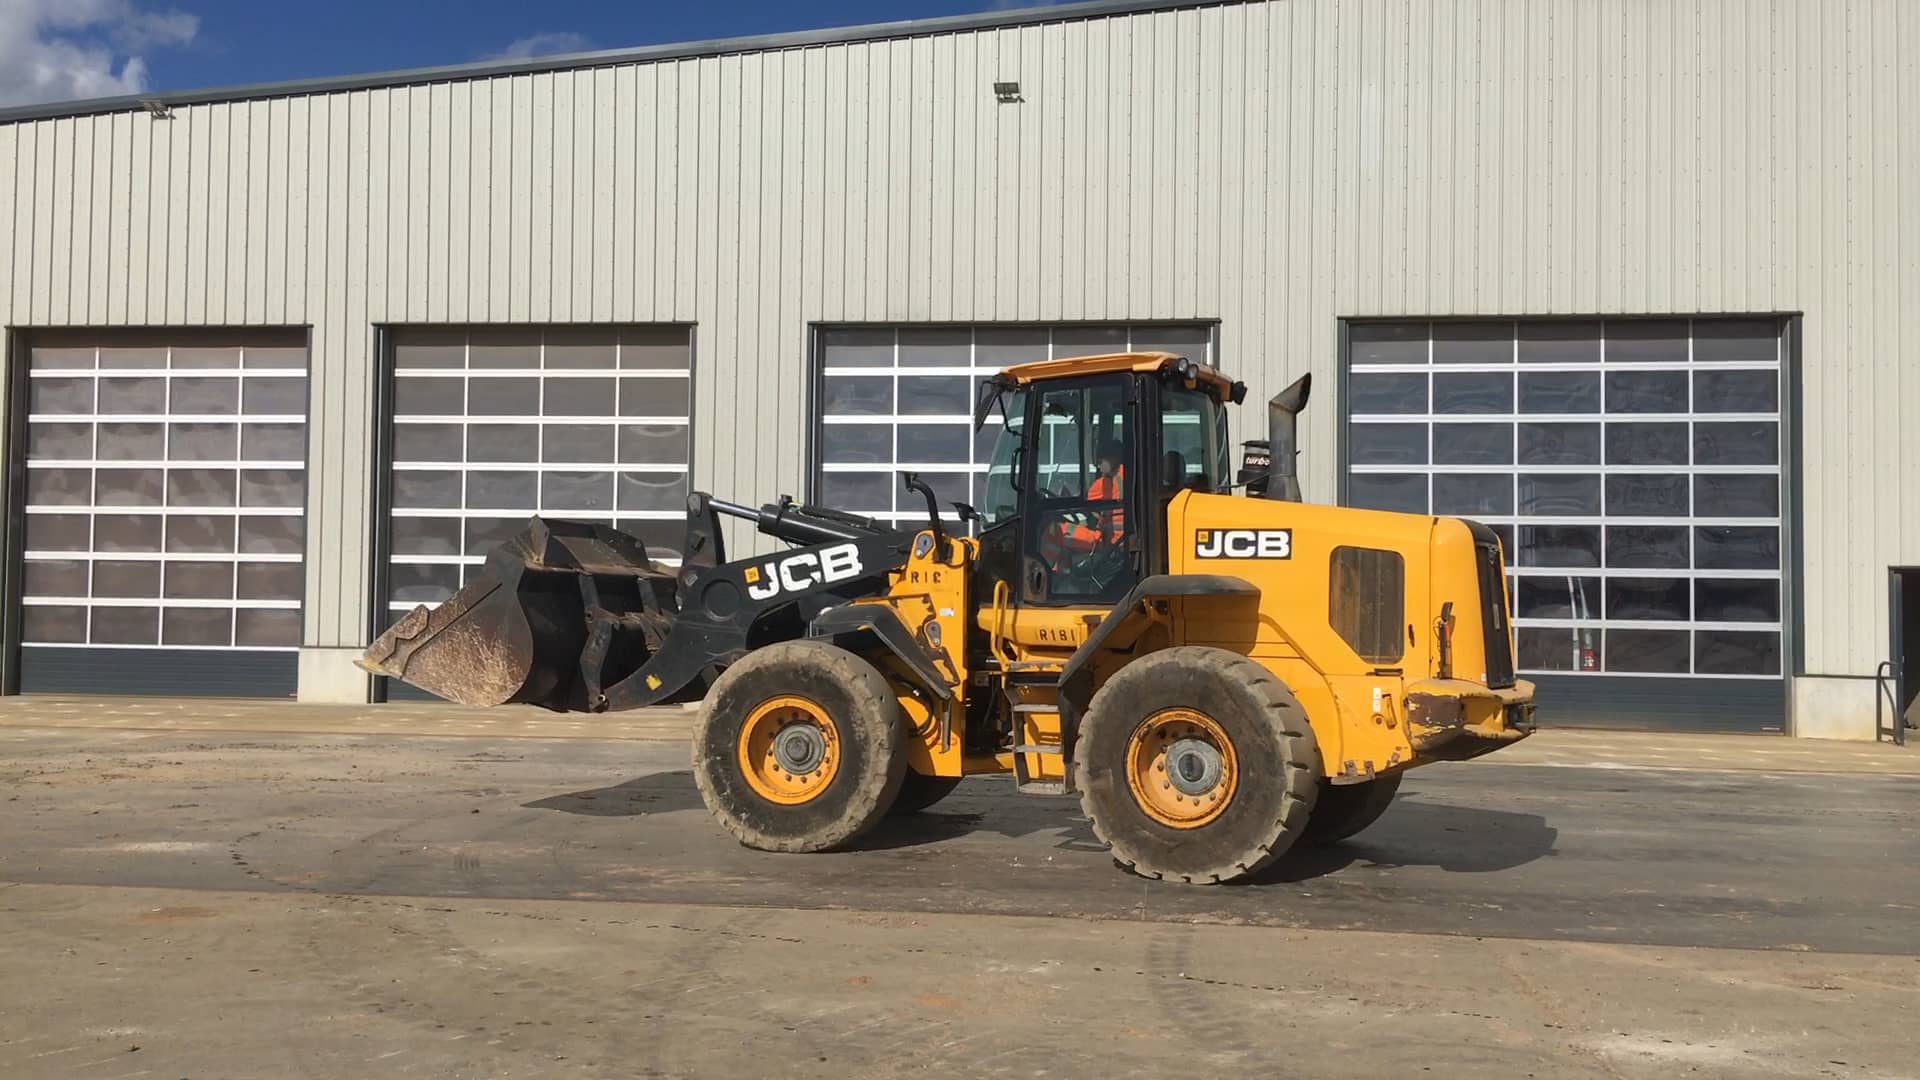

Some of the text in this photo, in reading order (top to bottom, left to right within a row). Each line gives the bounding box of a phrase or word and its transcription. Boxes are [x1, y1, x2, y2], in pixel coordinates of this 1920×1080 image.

[1245, 456, 1270, 466] turbo
[1197, 530, 1290, 558] JCB
[746, 543, 863, 600] JCB
